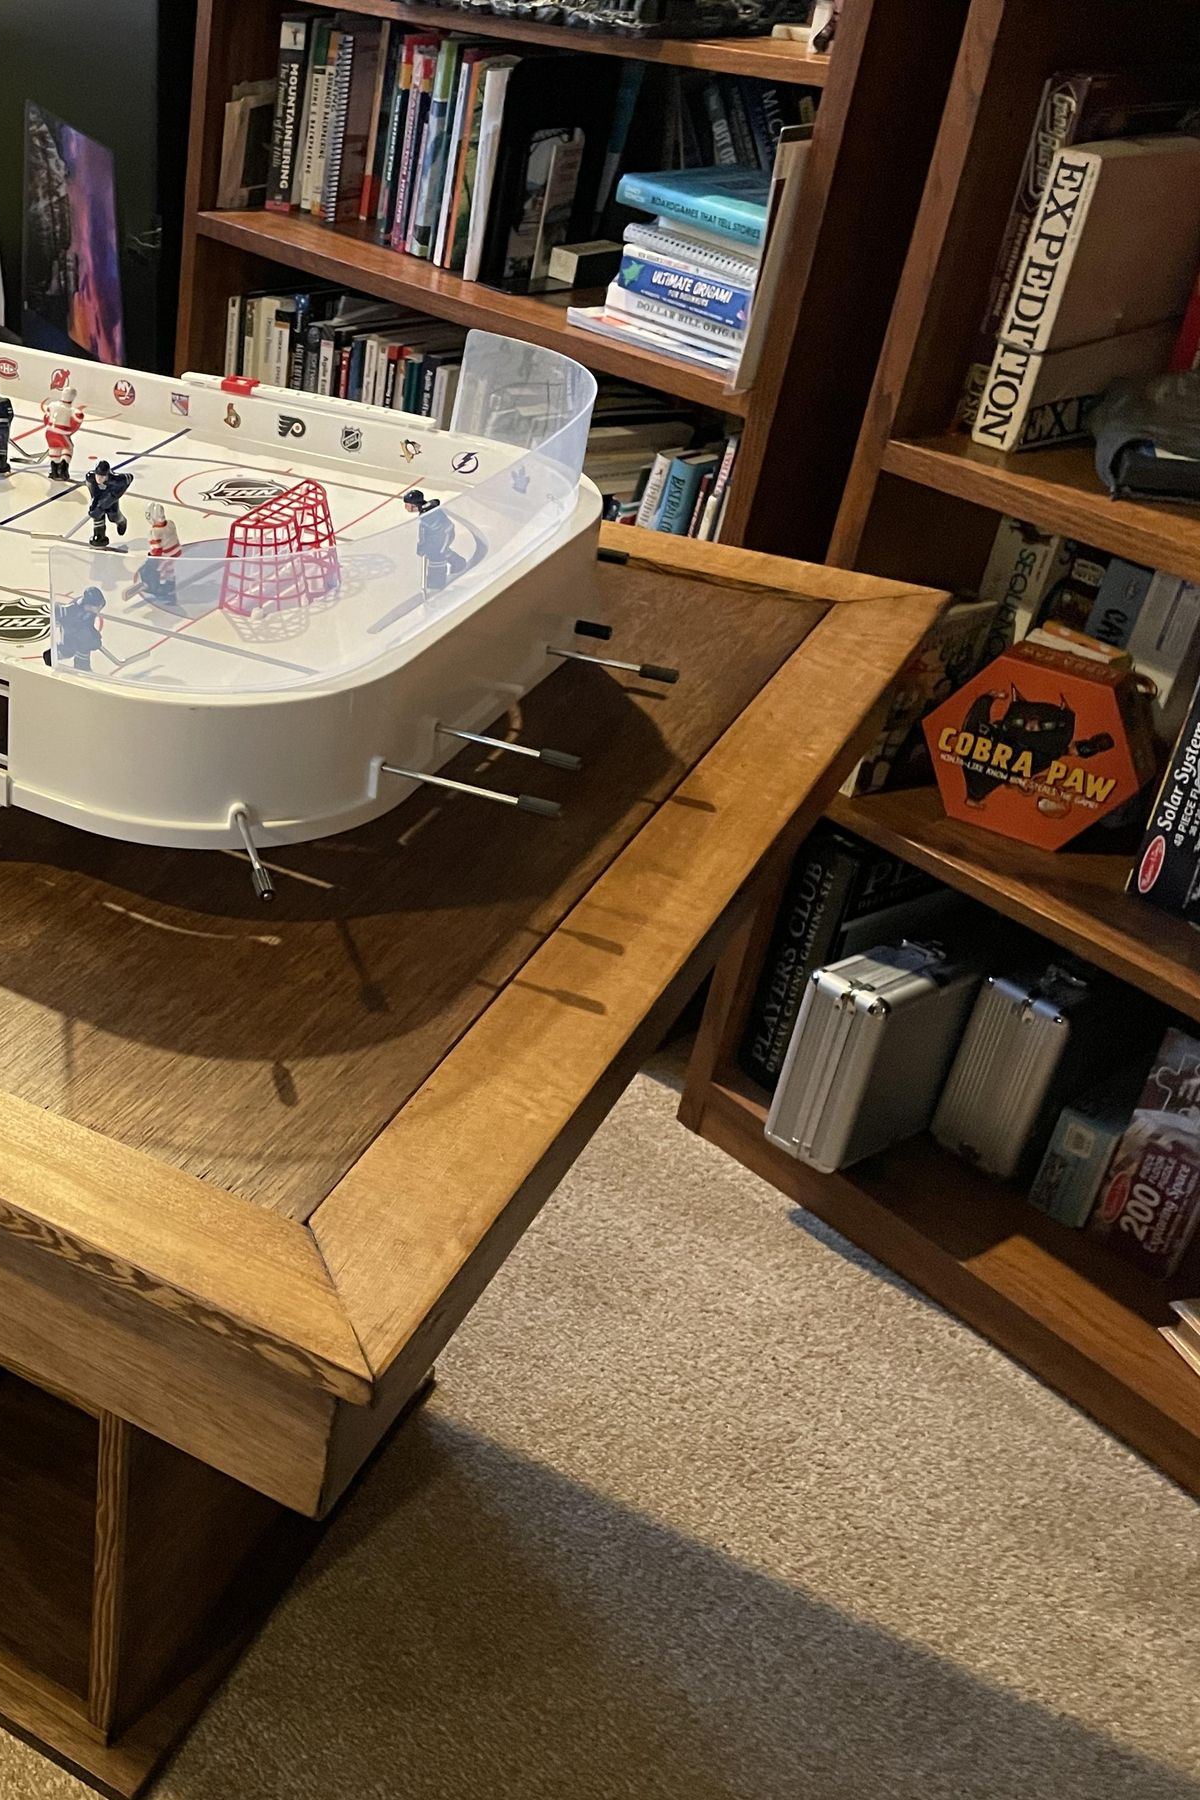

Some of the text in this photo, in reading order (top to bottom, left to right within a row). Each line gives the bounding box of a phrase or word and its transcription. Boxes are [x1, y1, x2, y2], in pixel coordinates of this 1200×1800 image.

[279, 63, 299, 190] MOUNTAINEERING
[651, 196, 699, 218] BOARDGAMES
[733, 221, 761, 240] STORIES
[637, 300, 678, 320] DOLLAR
[679, 312, 700, 328] BILL
[652, 270, 733, 304] ULTIMATE ORIGAMI
[979, 157, 1089, 444] EXPEDITION
[987, 548, 1036, 652] SEQUENC
[938, 727, 1116, 803] COBRA PAW
[1157, 784, 1183, 832] Solar
[1176, 798, 1197, 834] PIECE
[798, 901, 826, 962] GAMING
[818, 867, 836, 898] SET
[751, 862, 823, 1064] PLAYERS CLUB
[1120, 1183, 1161, 1242] 200
